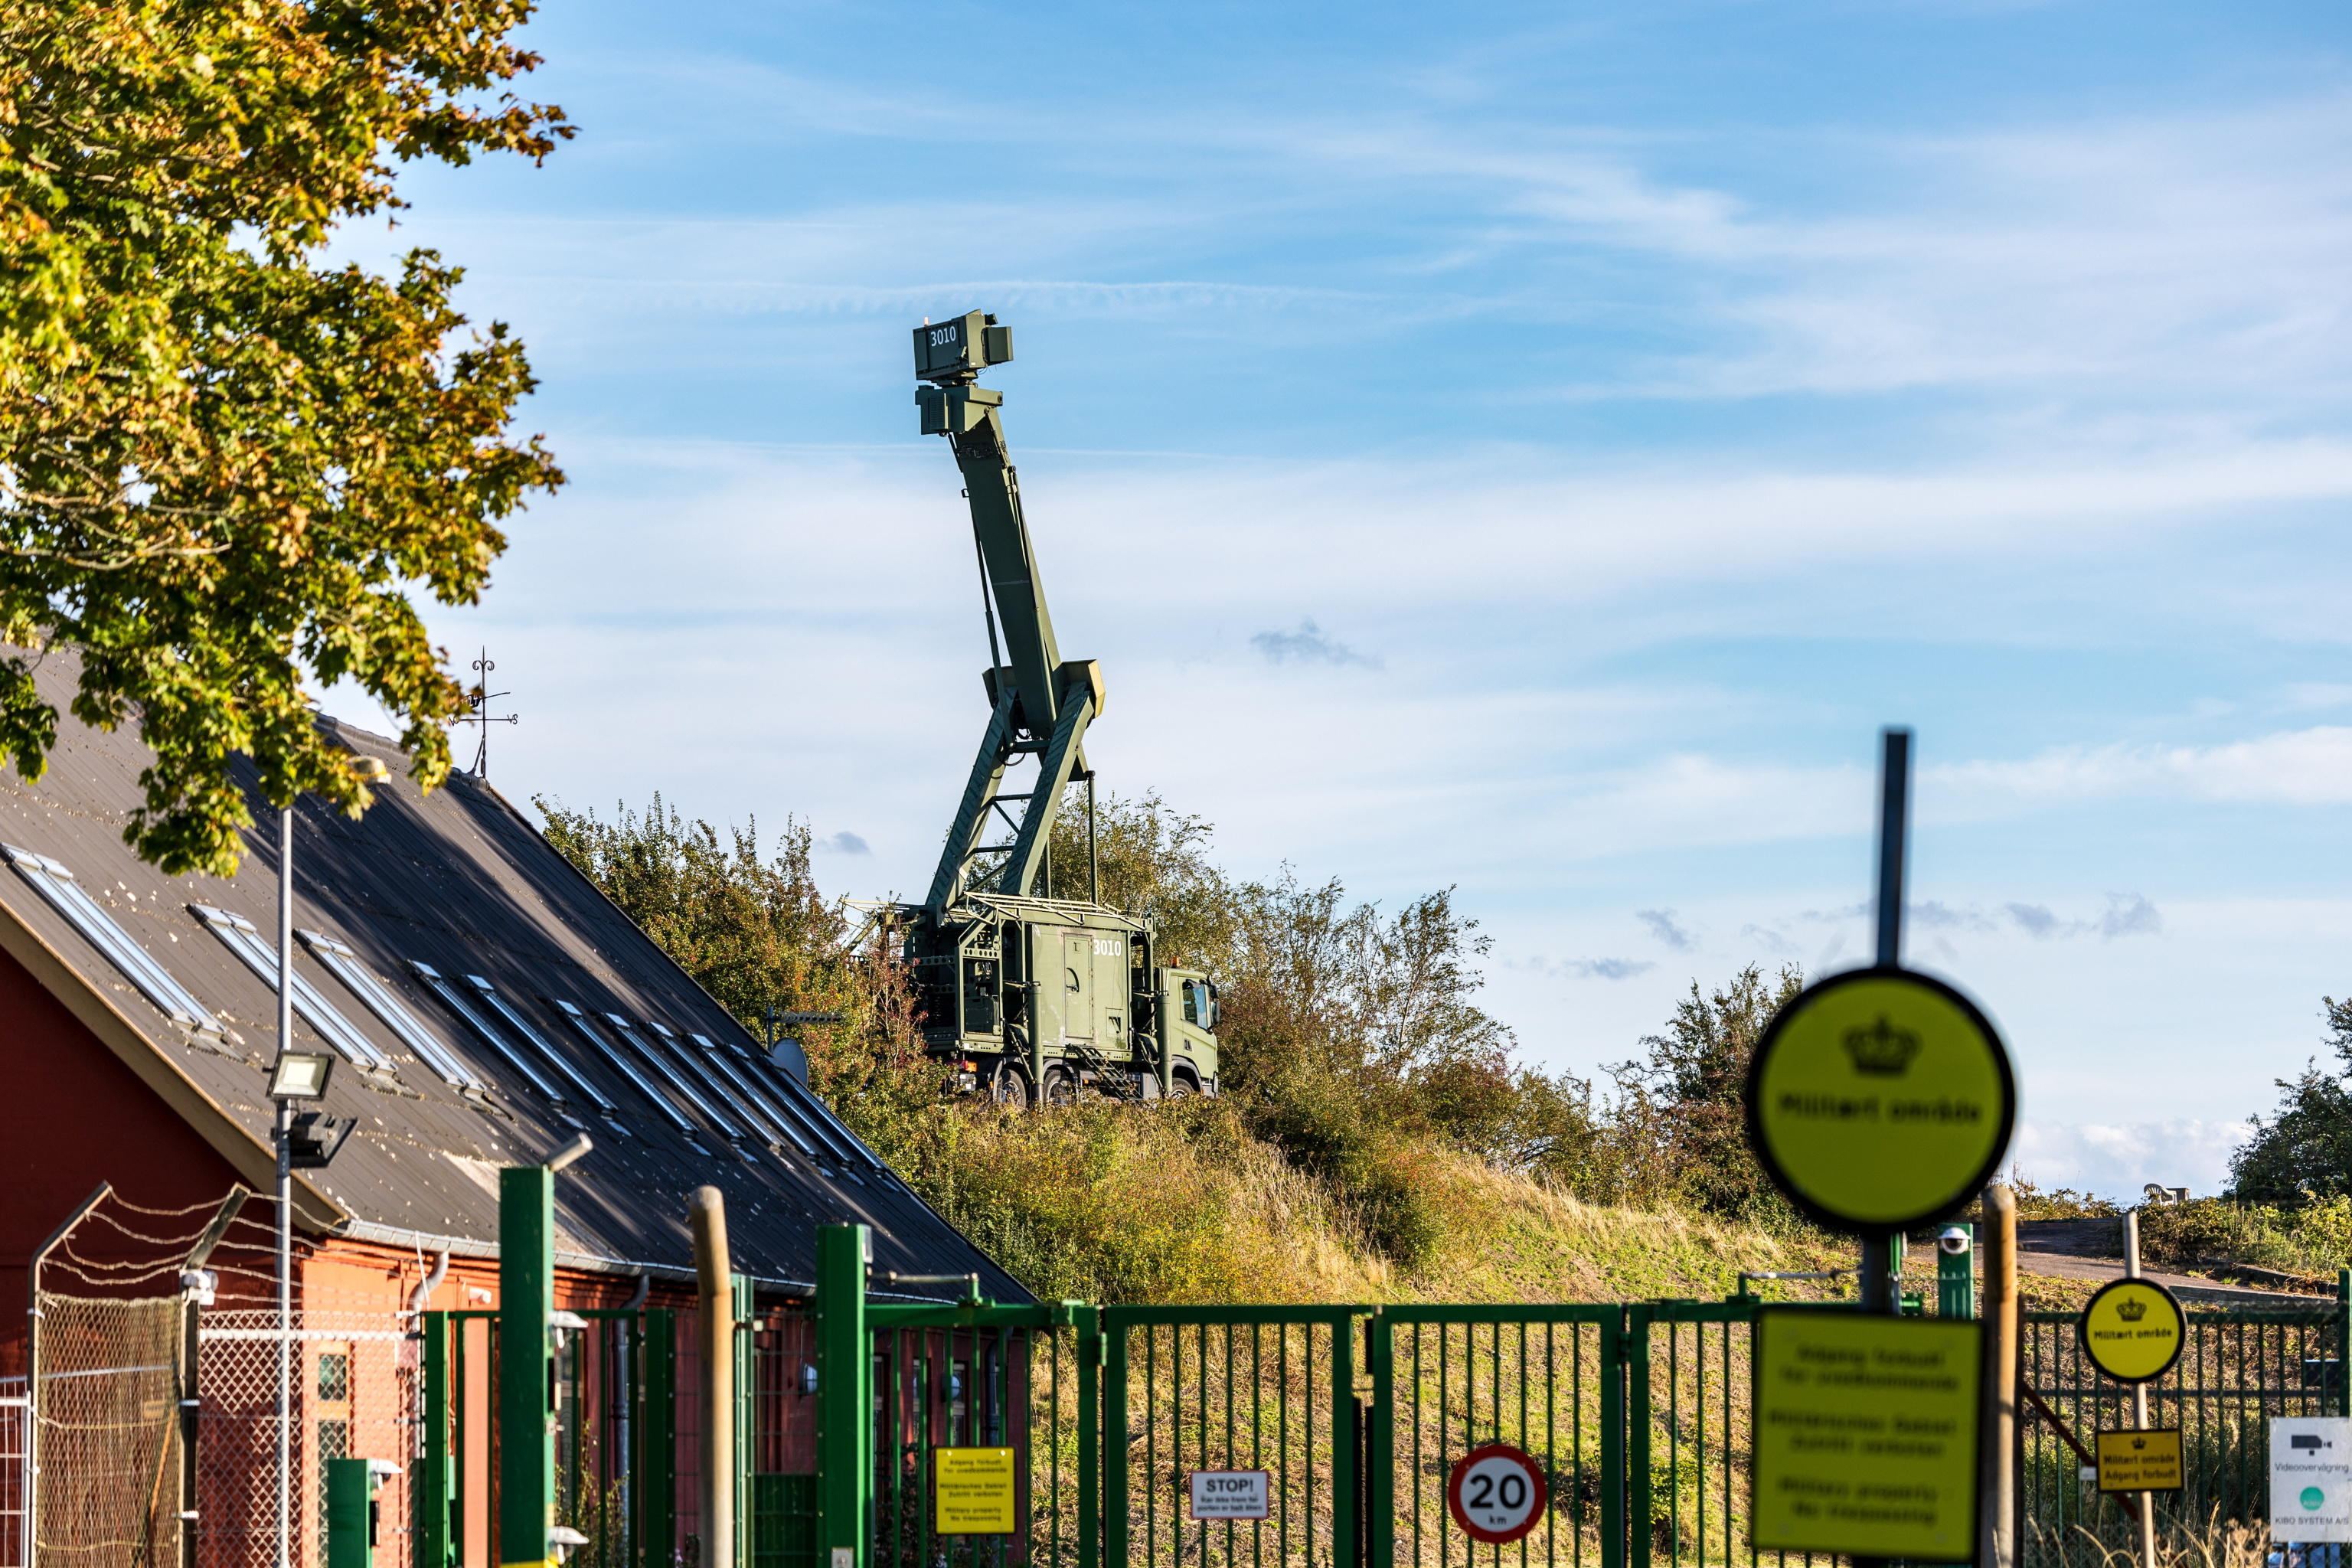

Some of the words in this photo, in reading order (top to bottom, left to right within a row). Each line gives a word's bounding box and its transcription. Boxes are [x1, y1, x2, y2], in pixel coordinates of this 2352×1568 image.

[931, 326, 956, 346] 3010
[1093, 939, 1122, 956] 3010
[2094, 1329, 2132, 1340] Militært
[2136, 1328, 2172, 1339] område
[2104, 1455, 2138, 1464] Militært
[2105, 1470, 2140, 1482] Adgang
[2143, 1468, 2177, 1478] forbudt
[2275, 1463, 2349, 1474] Videoovervågning
[1206, 1478, 1253, 1492] STOP!
[1470, 1474, 1526, 1509] 20
[1489, 1515, 1507, 1525] km
[2275, 1517, 2295, 1525] KIBO
[2298, 1517, 2333, 1525] SYSTEM
[2335, 1517, 2349, 1525] A/S
